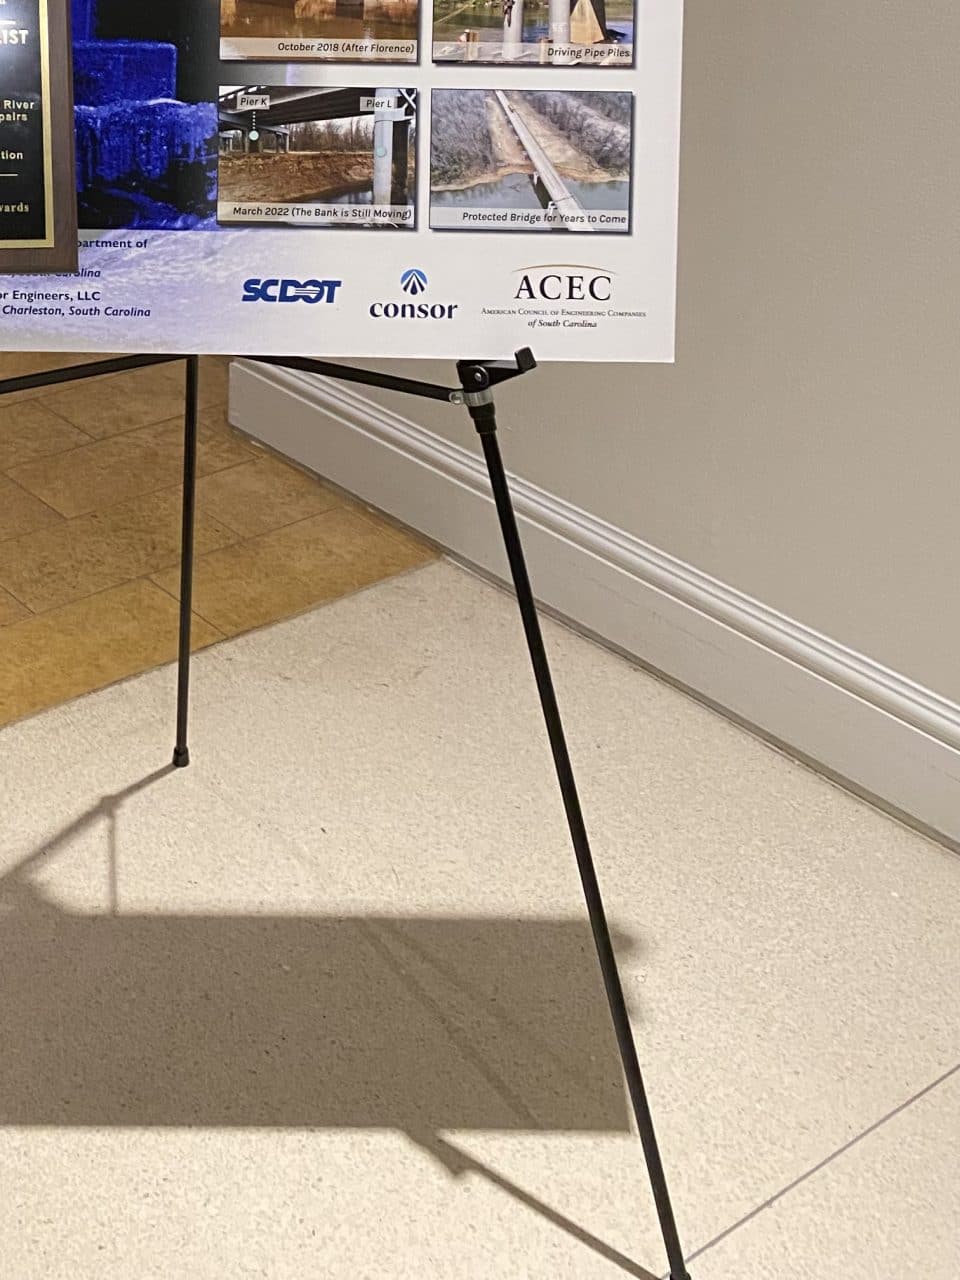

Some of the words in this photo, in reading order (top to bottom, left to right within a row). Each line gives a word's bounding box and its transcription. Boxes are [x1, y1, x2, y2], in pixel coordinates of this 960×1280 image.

[277, 42, 315, 51] October
[316, 42, 339, 52] 2018
[341, 42, 368, 53] (After
[370, 43, 415, 54] Florence)
[547, 48, 582, 58] Driving
[584, 48, 605, 59] Pipe
[607, 48, 630, 57] Piles
[3, 100, 35, 109] River
[240, 97, 258, 106] Pier
[366, 99, 385, 108] Pier
[232, 206, 262, 215] March
[264, 206, 289, 216] 2022
[291, 207, 312, 217] (The
[314, 207, 338, 217] Bank
[340, 208, 349, 217] is
[351, 208, 371, 218] Still
[373, 209, 412, 220] Moving)
[462, 212, 507, 221] Protected
[511, 213, 540, 224] Bridge
[543, 213, 557, 222] for
[560, 214, 585, 223] Years
[587, 215, 597, 223] to
[599, 215, 627, 223] Come
[136, 239, 148, 248] of
[241, 278, 341, 303] SCDOT
[515, 275, 612, 301] ACEC
[12, 290, 73, 303] Engineers,
[77, 290, 100, 301] LLC
[1, 304, 64, 316] Charleston,
[68, 305, 100, 316] South
[103, 306, 150, 317] Carolina
[369, 302, 458, 319] consor
